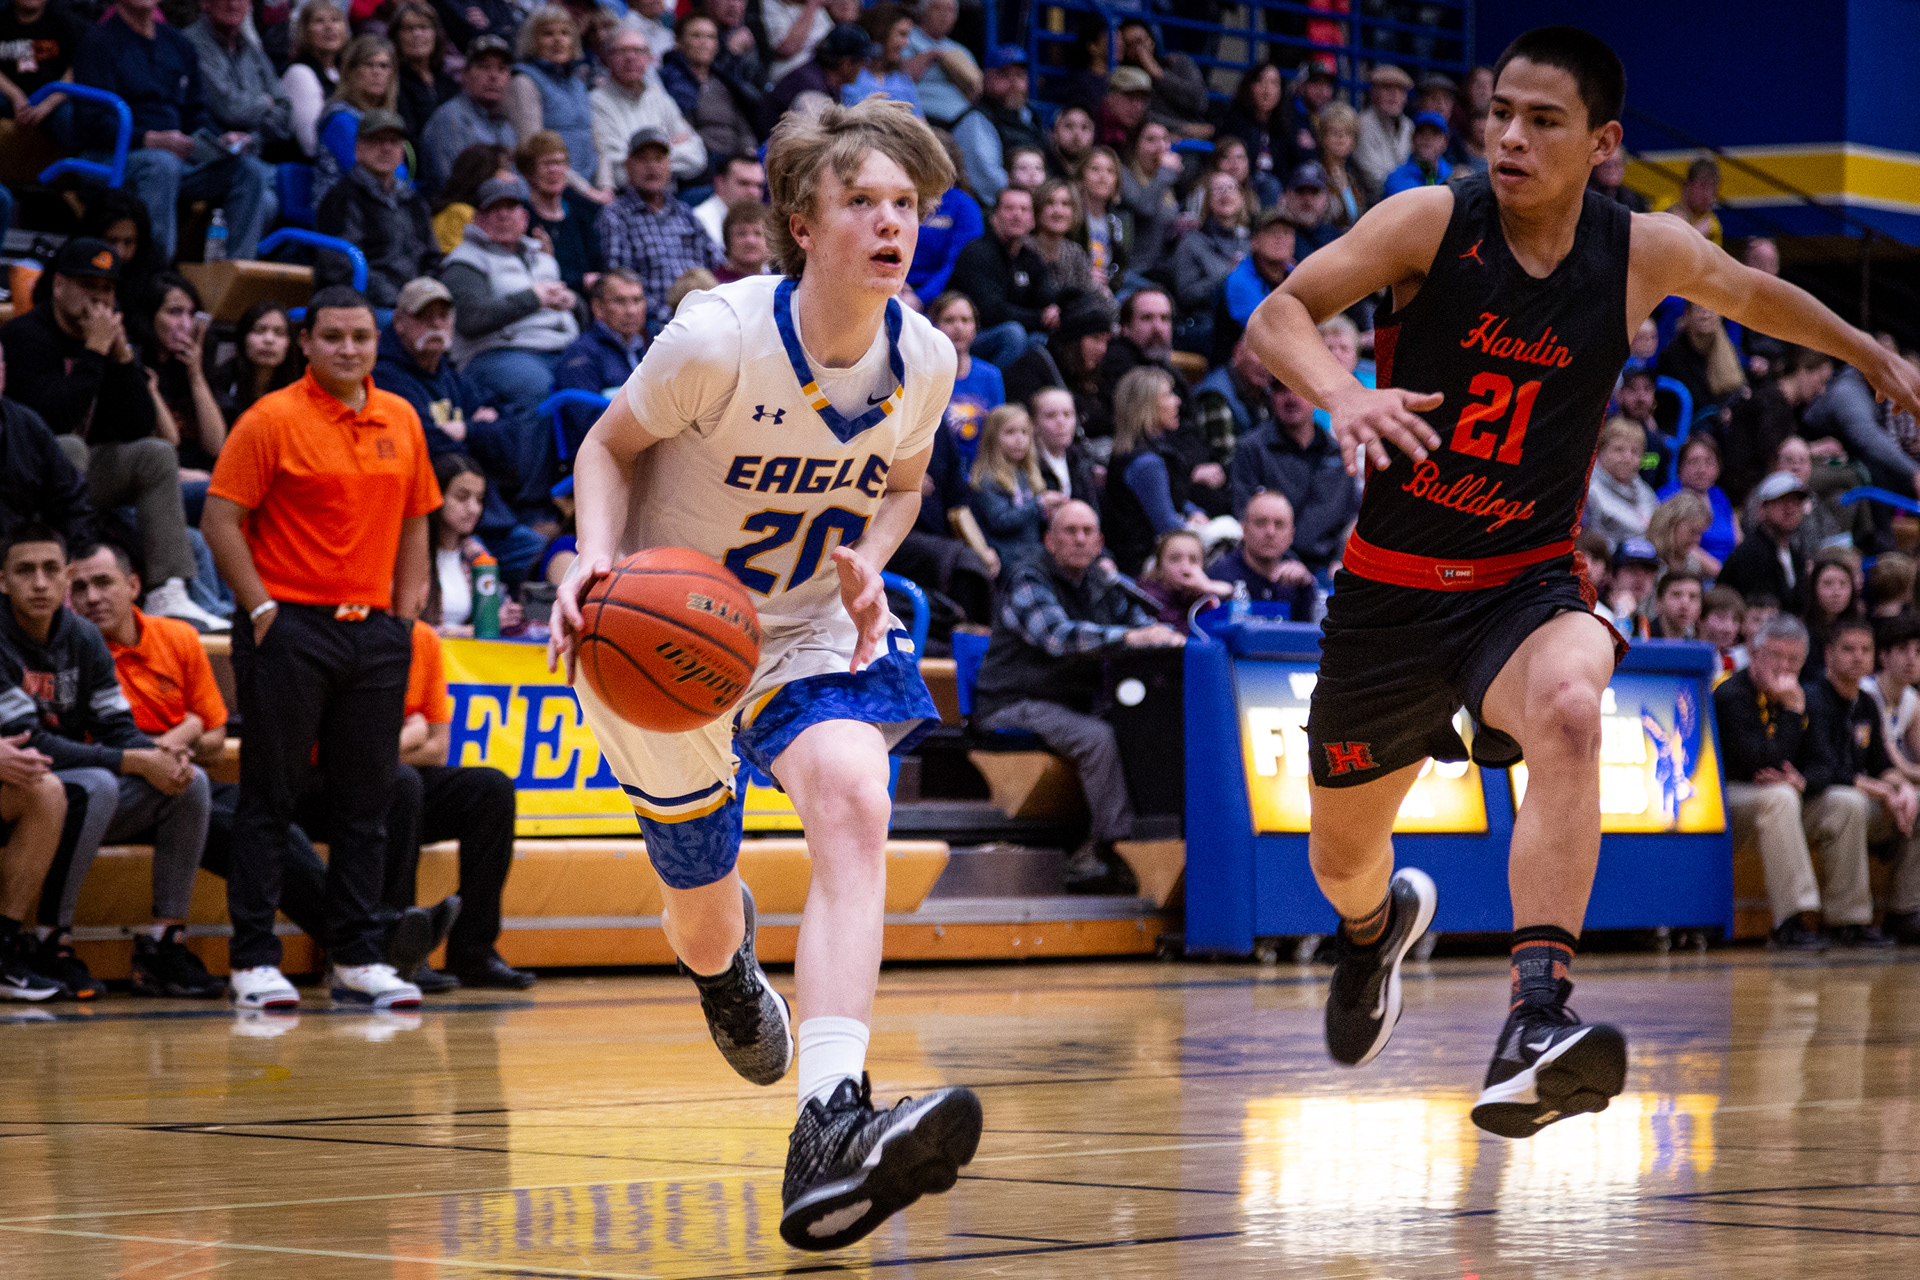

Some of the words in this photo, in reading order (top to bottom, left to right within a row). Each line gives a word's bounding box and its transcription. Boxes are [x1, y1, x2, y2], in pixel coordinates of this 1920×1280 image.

[1460, 312, 1573, 368] Hardin
[1450, 371, 1542, 466] 21
[724, 454, 890, 499] EAGLE
[1402, 459, 1536, 533] Bulldogs
[723, 505, 872, 598] 20
